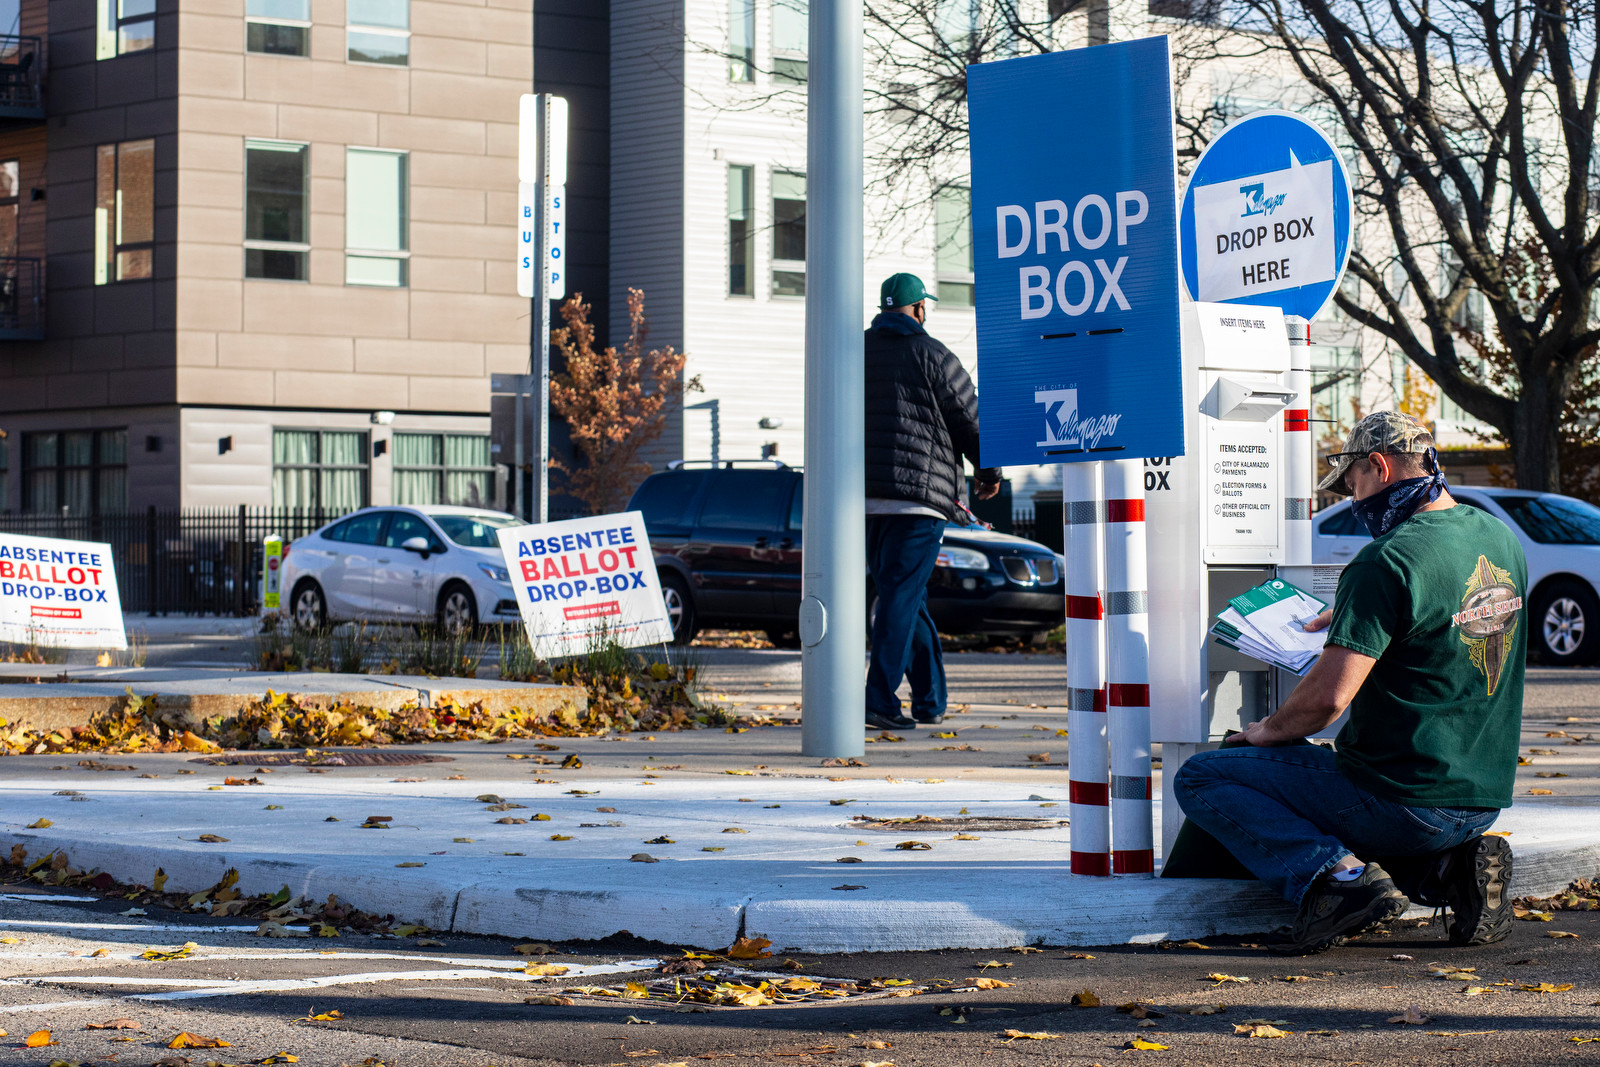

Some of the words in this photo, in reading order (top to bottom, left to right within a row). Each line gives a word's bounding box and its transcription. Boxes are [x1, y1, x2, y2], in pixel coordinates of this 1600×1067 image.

[996, 190, 1149, 259] DROP
[1216, 226, 1267, 255] DROP
[1274, 216, 1315, 243] BOX
[523, 206, 532, 268] BUS
[551, 197, 561, 284] STOP
[1242, 258, 1290, 286] HERE
[886, 296, 894, 306] S
[1019, 256, 1133, 320] BOX
[1220, 317, 1237, 327] INSERT
[1237, 318, 1252, 328] ITEMS
[1252, 320, 1266, 329] HERE
[1220, 444, 1237, 452] ITEMS
[1238, 445, 1267, 454] ACCEPTED:
[1222, 460, 1232, 468] CITY
[1144, 470, 1171, 491] OX
[518, 526, 635, 558] ABSENTEE
[0, 545, 102, 567] ABSENTEE
[519, 546, 638, 582] BALLOT
[0, 560, 102, 586] BALLOT
[2, 582, 108, 603] DROP-BOX
[526, 570, 647, 603] DROP-BOX
[1451, 604, 1494, 628] NORTH
